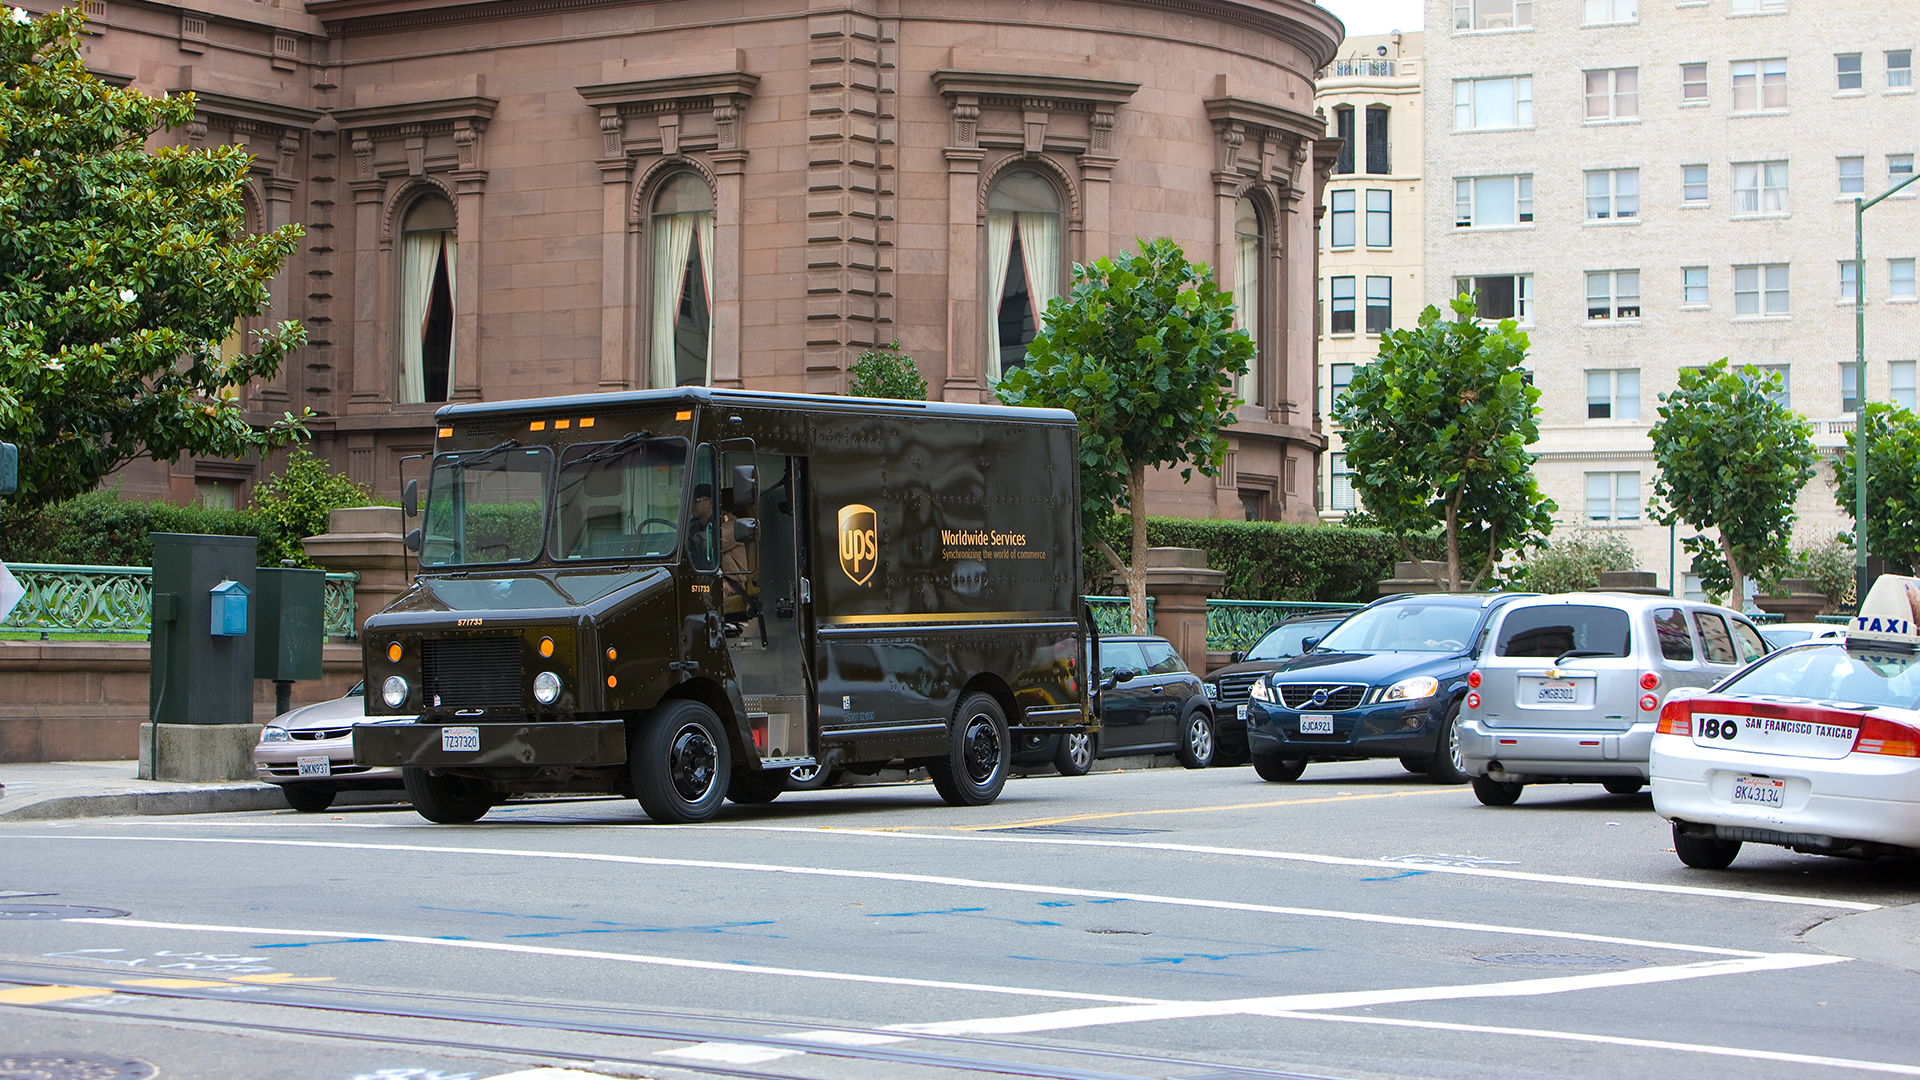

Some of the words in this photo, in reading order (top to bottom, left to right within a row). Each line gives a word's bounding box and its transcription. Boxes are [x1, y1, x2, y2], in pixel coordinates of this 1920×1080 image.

[941, 529, 989, 546] Worldwide
[990, 530, 1026, 546] Services
[840, 529, 876, 573] ups
[942, 548, 982, 562] Synchronizing
[982, 549, 993, 559] the
[993, 549, 1010, 559] world
[1010, 549, 1017, 559] of
[1017, 550, 1047, 560] commerce
[691, 585, 710, 593] 571733
[457, 618, 483, 627] 571733
[1857, 617, 1908, 634] TAXI
[843, 712, 859, 722] USDOT
[1301, 721, 1331, 731] 6JCA921
[1698, 718, 1738, 740] 180
[1745, 718, 1762, 729] SAN
[1765, 720, 1812, 735] FRANCISCO
[1816, 725, 1853, 739] TAXICAB
[444, 735, 477, 748] 7Z37320
[300, 763, 328, 775] 3WKN937
[1734, 785, 1779, 803] 8K43134
